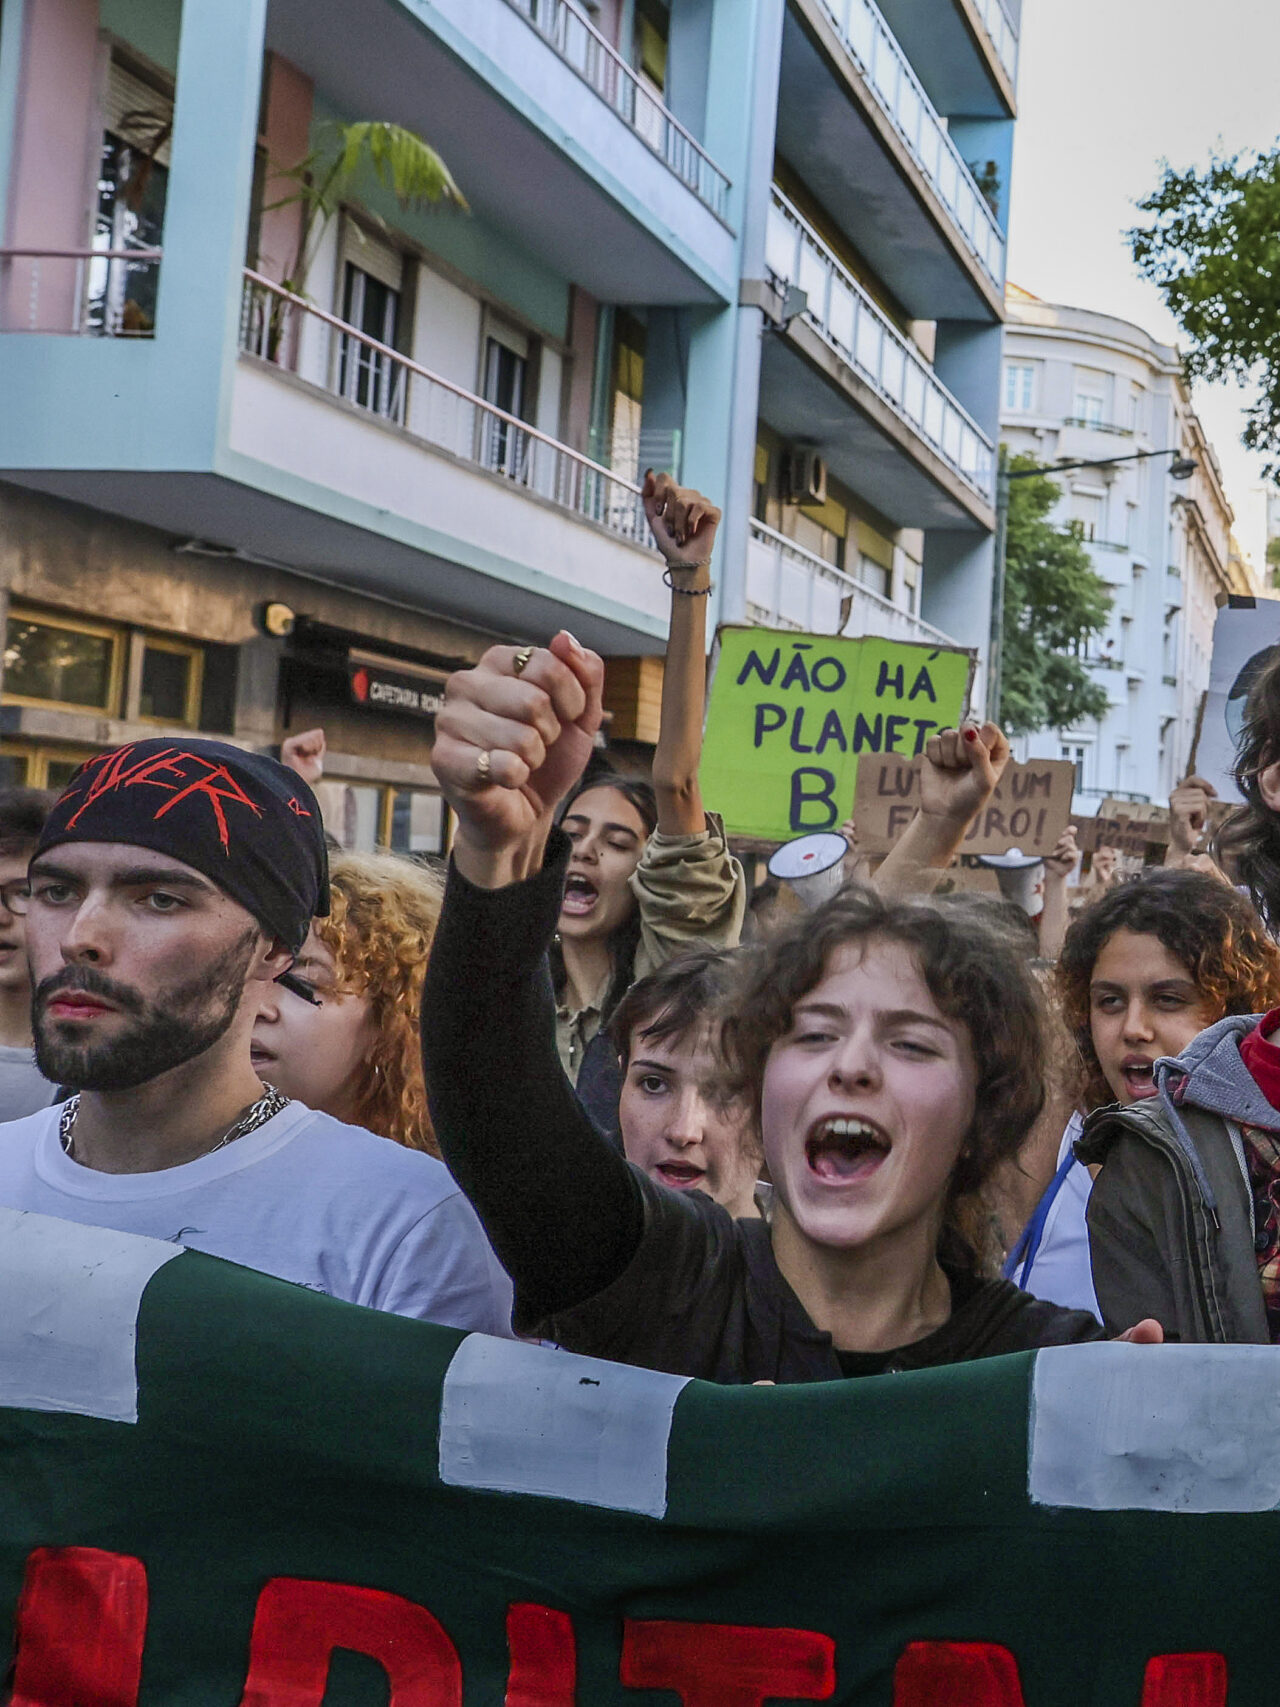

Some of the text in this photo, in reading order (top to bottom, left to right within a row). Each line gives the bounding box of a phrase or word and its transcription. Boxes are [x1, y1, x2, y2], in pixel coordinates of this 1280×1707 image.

[736, 643, 937, 703] NÃO HÁ
[754, 703, 954, 757] PLANET
[789, 767, 838, 832] B
[1012, 770, 1053, 799] UM
